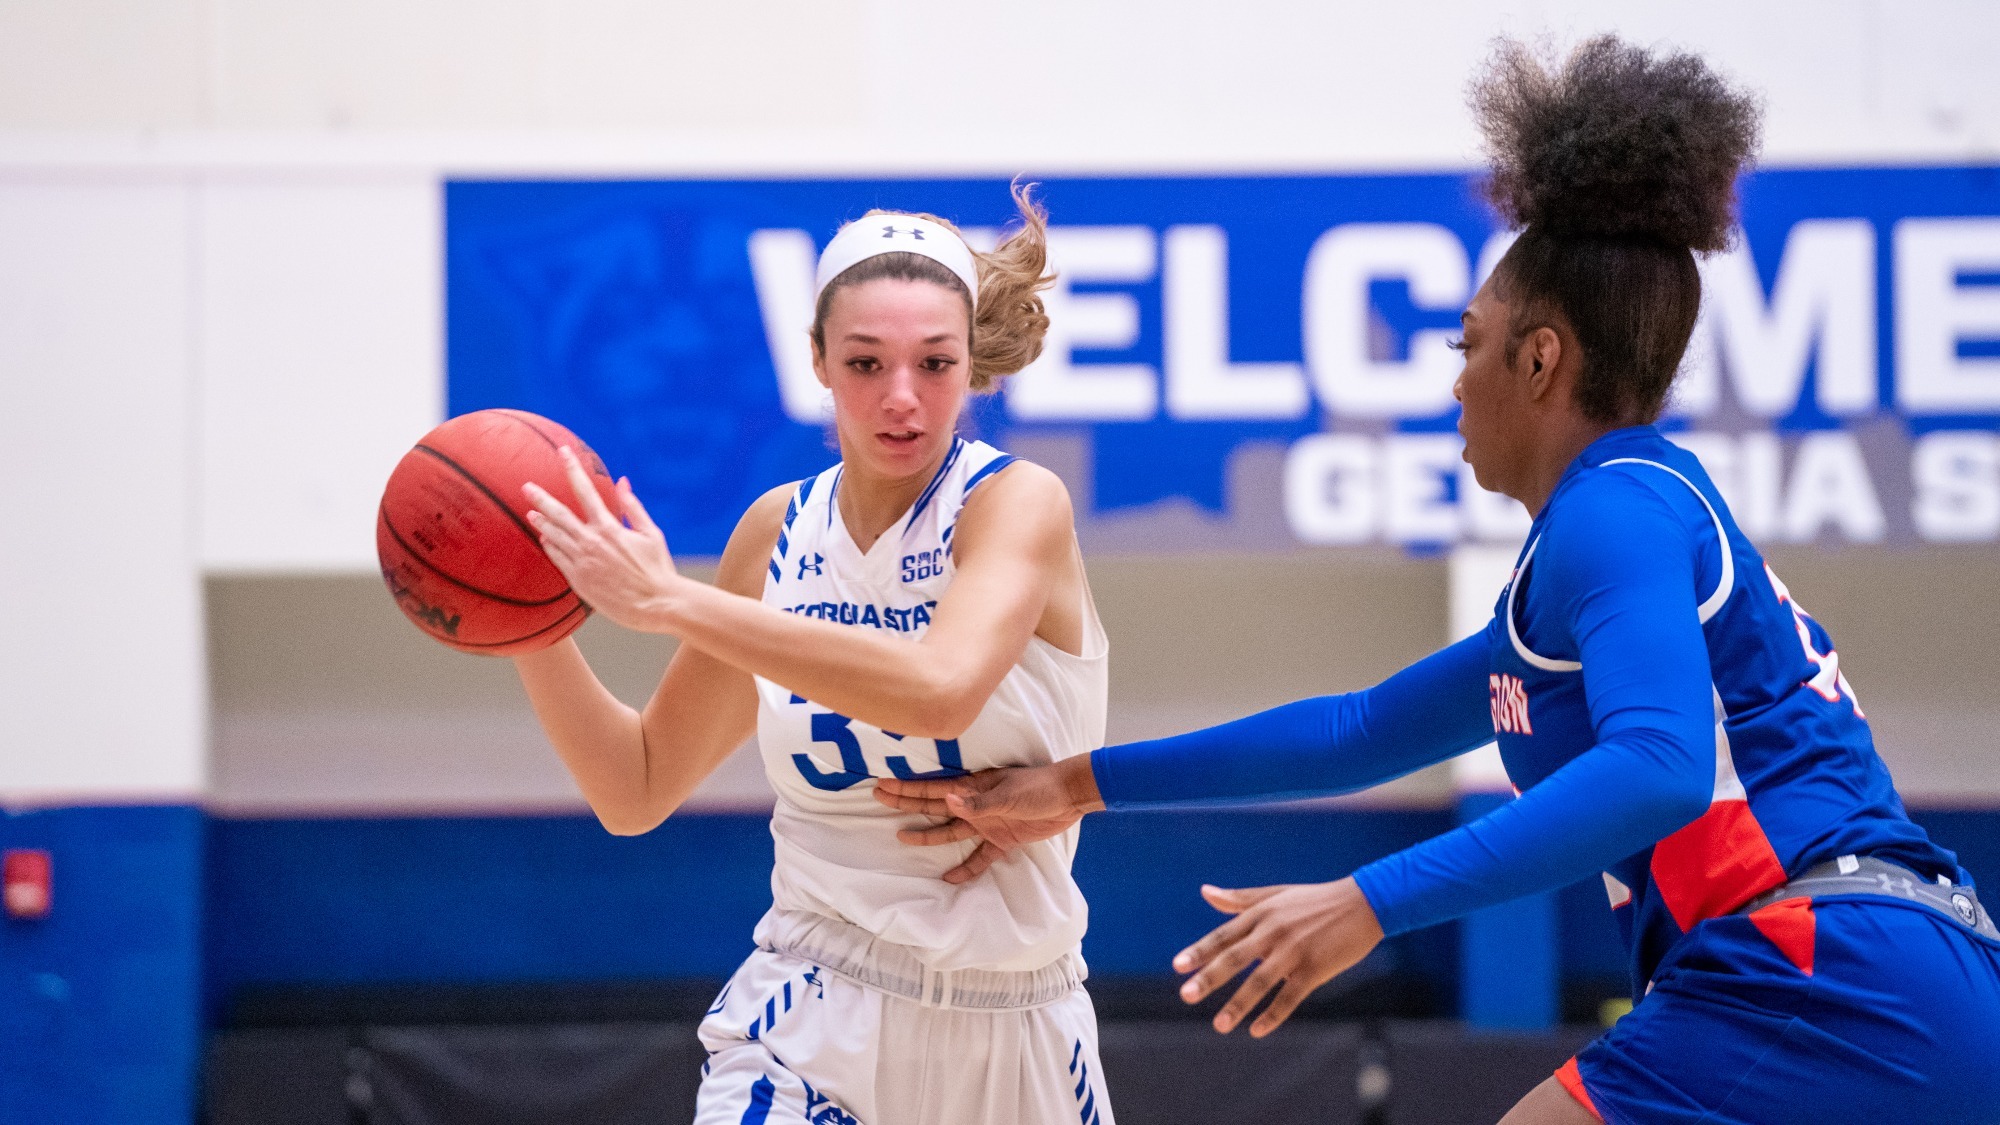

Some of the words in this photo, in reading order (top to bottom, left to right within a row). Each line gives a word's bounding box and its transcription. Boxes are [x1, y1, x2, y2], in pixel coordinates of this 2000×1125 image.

[748, 217, 2000, 423] ELCME
[1284, 432, 1889, 544] GEIA
[782, 601, 882, 628] ORGIA
